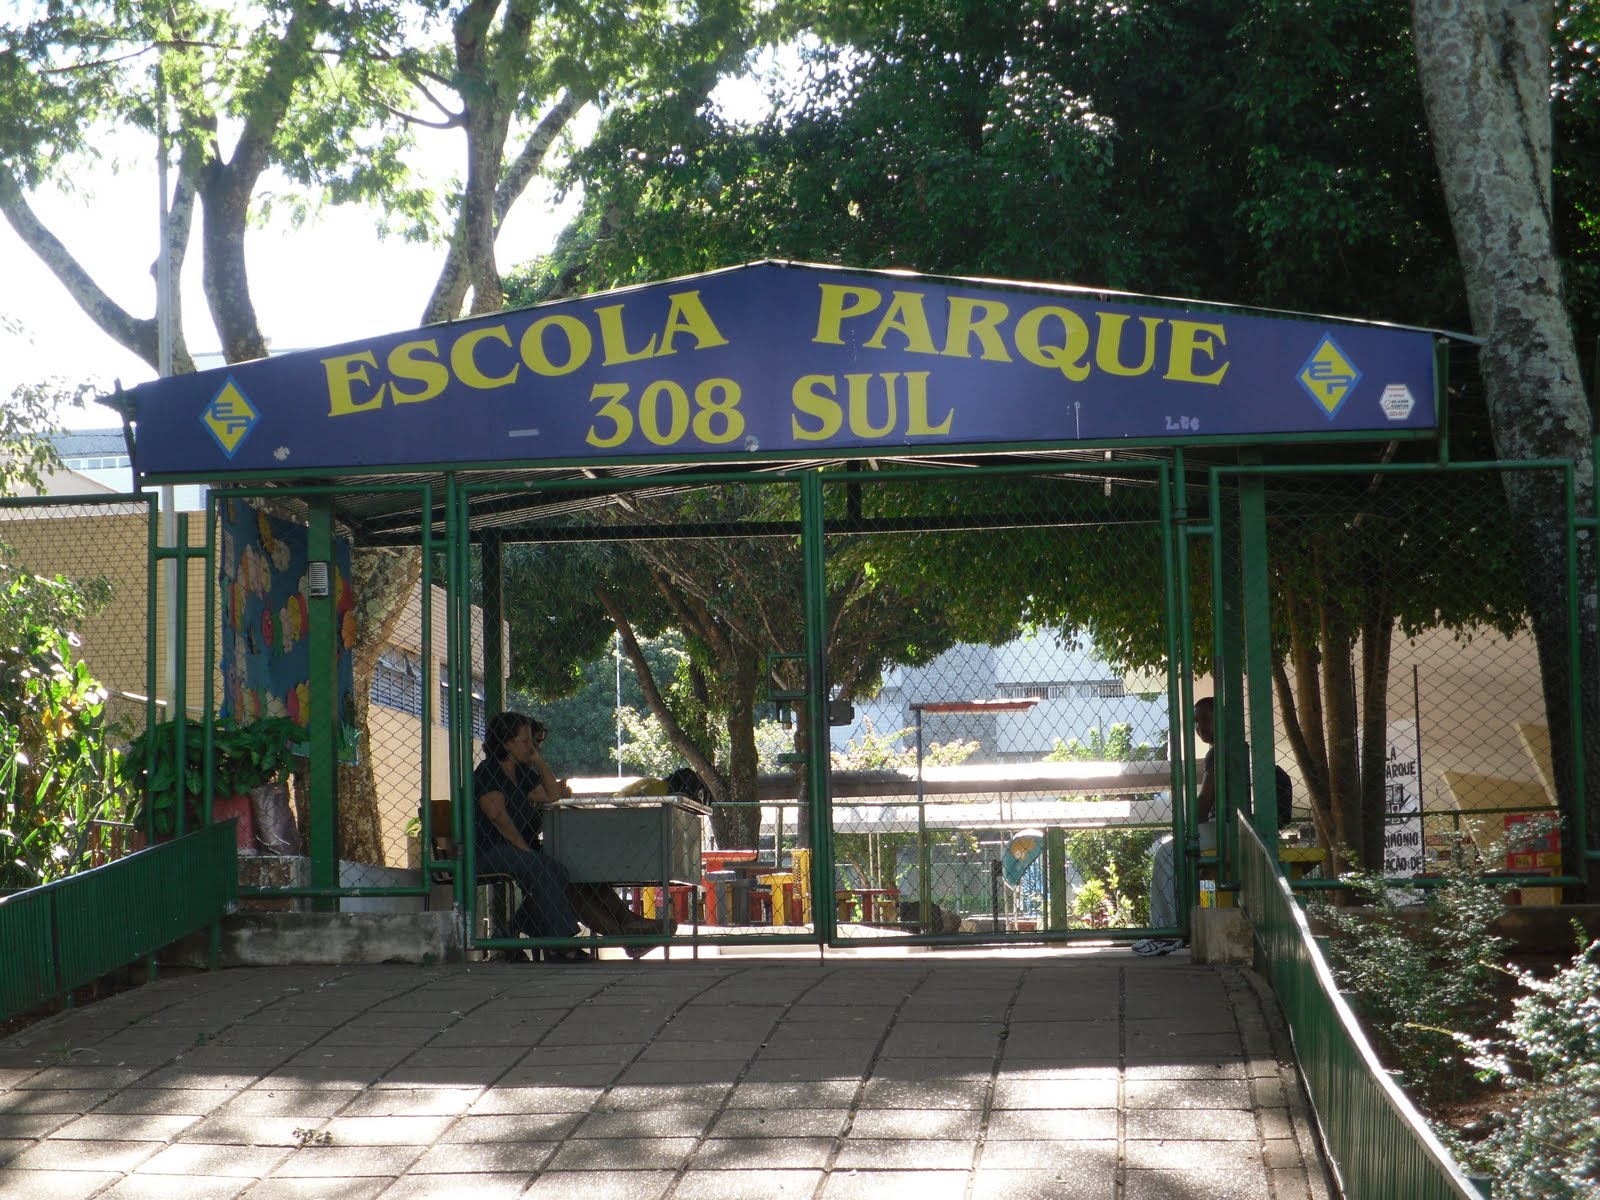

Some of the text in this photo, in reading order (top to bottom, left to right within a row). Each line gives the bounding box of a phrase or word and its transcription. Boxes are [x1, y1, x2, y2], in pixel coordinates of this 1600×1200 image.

[320, 283, 1230, 418] ESCOLA PARQUE
[585, 371, 954, 448] 308 SUL
[1386, 760, 1416, 779] ARQUE
[1385, 829, 1419, 849] RIMÔNIO
[1385, 855, 1407, 872] AÇÃO
